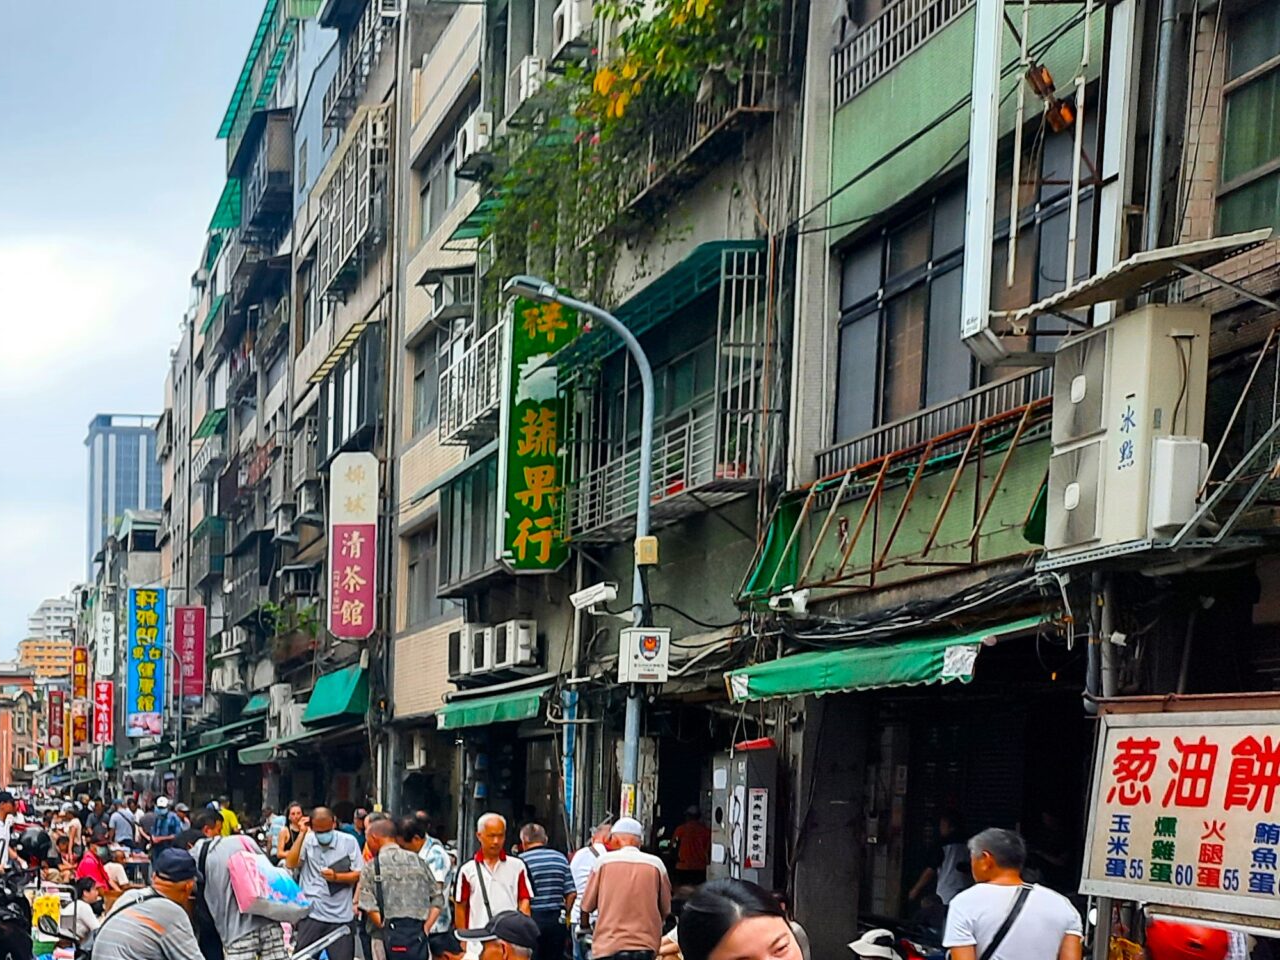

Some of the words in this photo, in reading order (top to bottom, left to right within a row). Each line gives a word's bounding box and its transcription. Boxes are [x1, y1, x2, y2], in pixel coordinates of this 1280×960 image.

[1105, 814, 1131, 879] 玉米蛋
[1129, 858, 1144, 880] 55
[1149, 816, 1178, 885] 燻雞蛋
[1175, 864, 1193, 886] 60
[1196, 820, 1226, 889] 火腿蛋
[1223, 868, 1240, 891] 55
[1247, 822, 1280, 895] 鮪魚蛋
